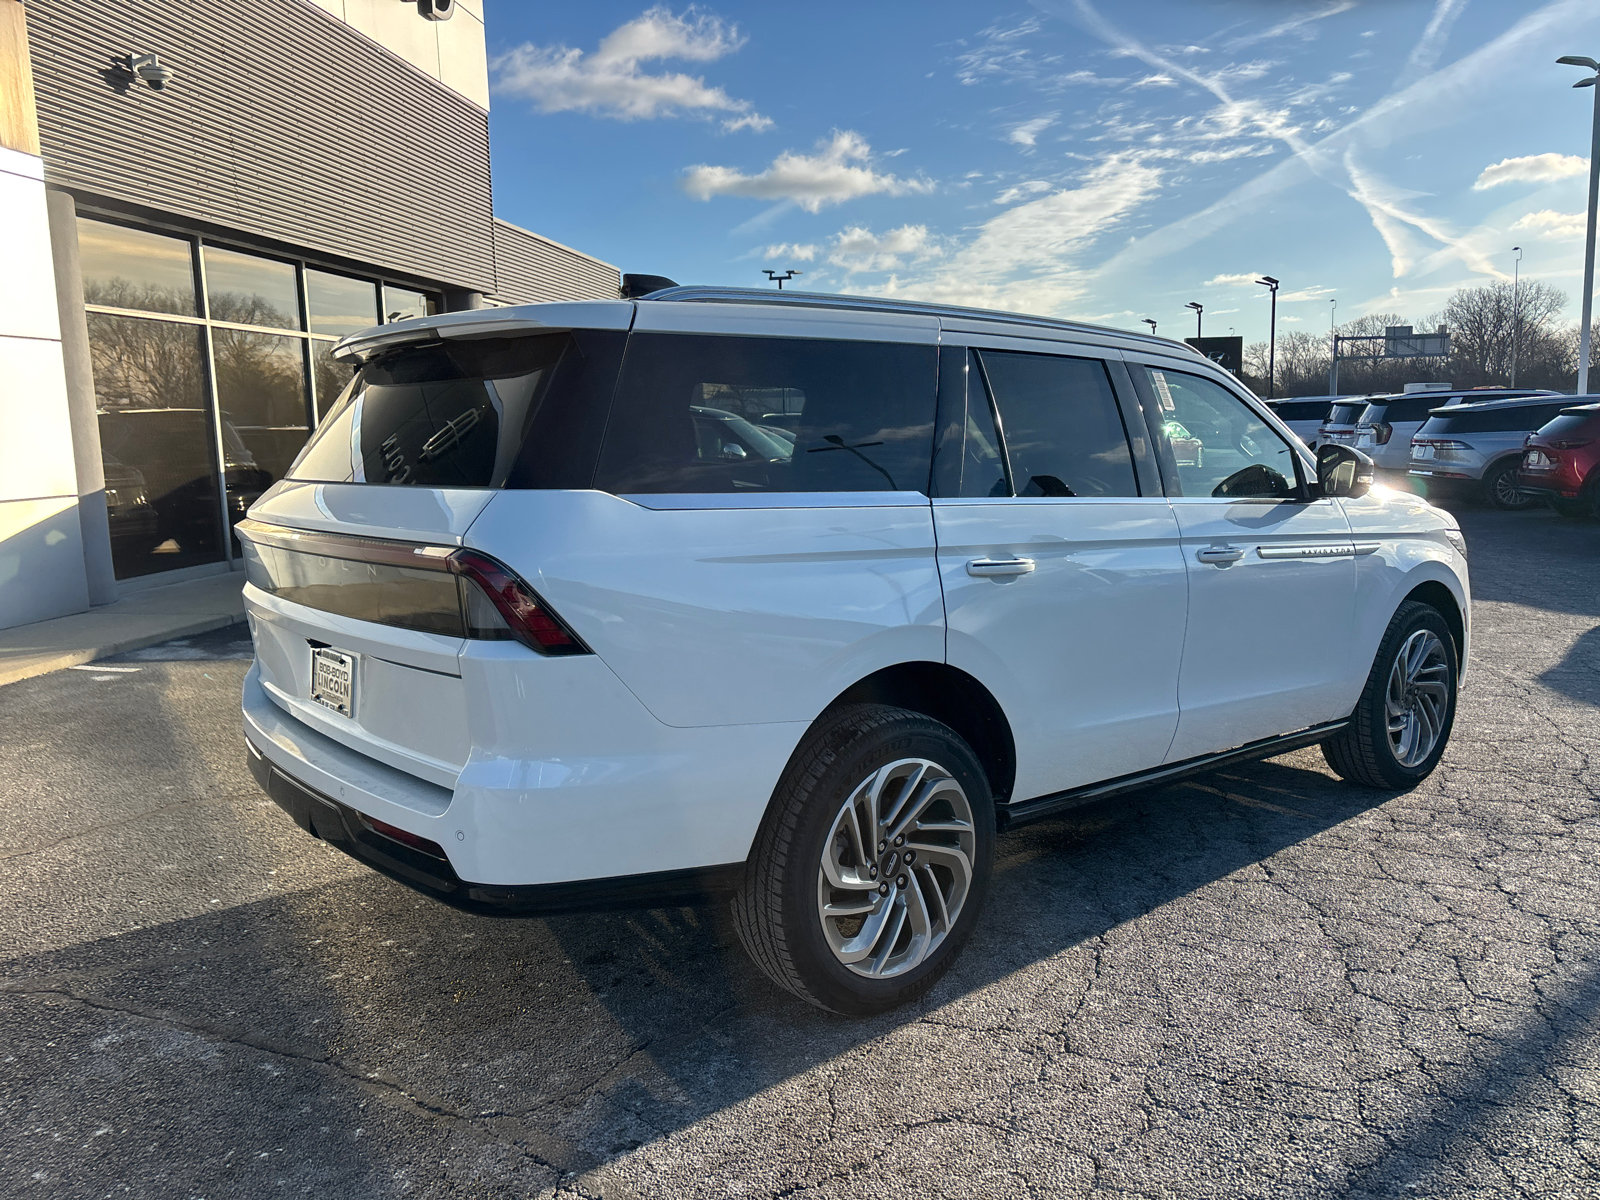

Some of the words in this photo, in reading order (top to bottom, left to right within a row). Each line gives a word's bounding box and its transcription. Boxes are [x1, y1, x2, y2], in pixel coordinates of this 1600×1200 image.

[1301, 547, 1351, 556] NAVIGATOR
[319, 662, 348, 682] BOB-BOYD
[318, 673, 349, 697] LINCOLN
